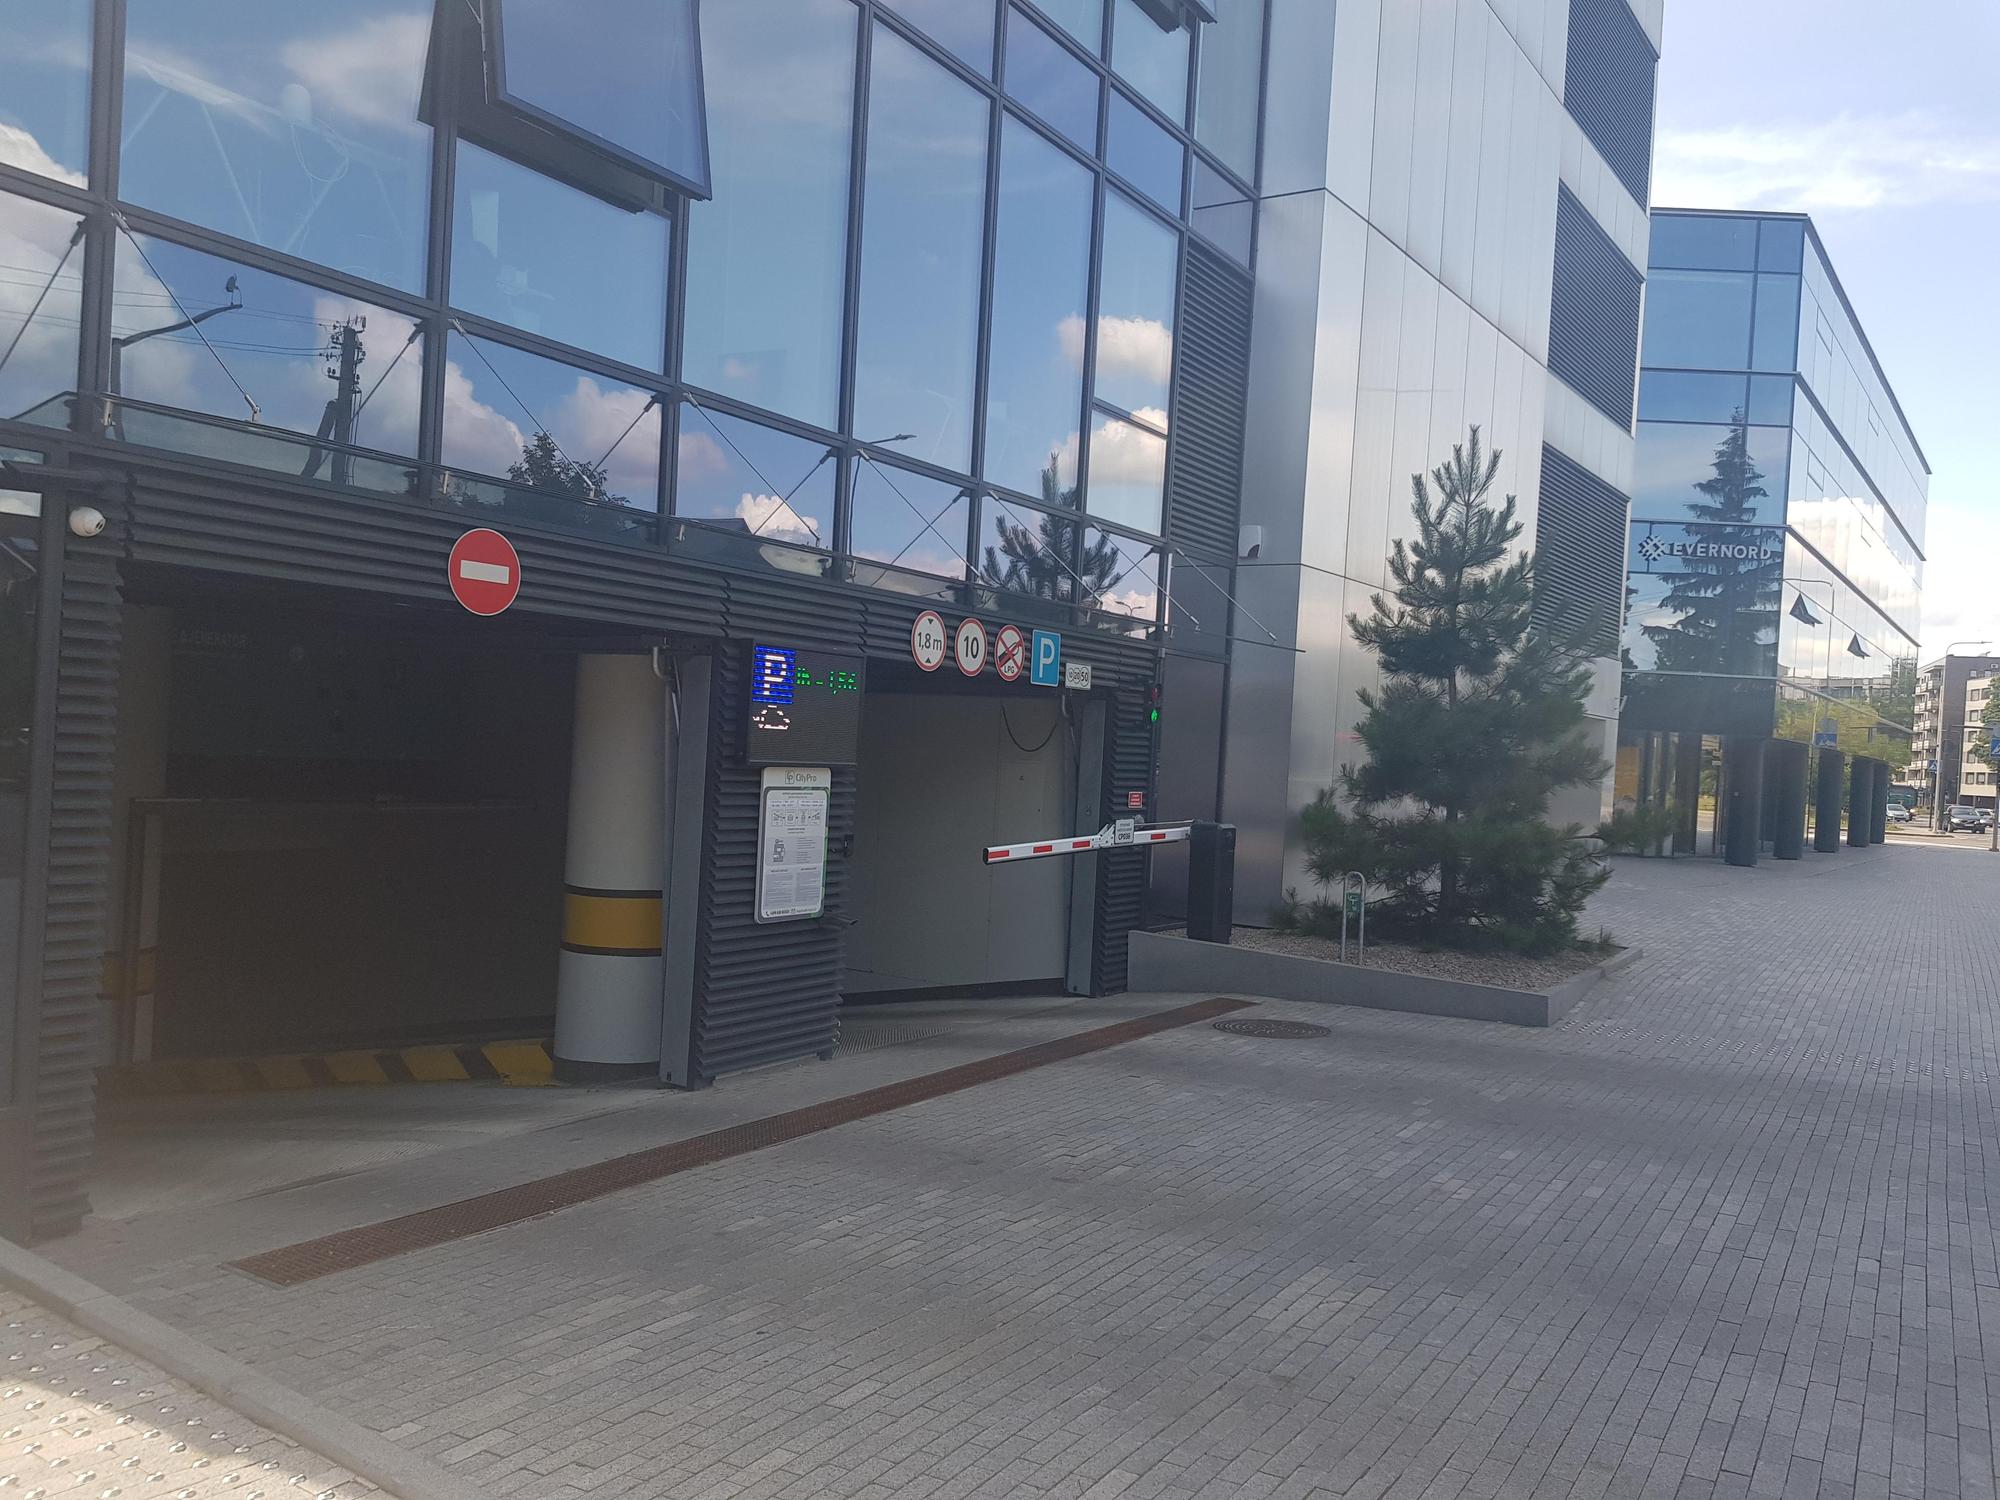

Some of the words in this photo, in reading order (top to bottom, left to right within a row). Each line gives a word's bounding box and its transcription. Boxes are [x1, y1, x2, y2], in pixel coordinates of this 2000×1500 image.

[1673, 543, 1771, 560] EVERNORD
[917, 632, 931, 650] 1,8
[963, 635, 979, 659] 10
[1038, 637, 1055, 679] P
[763, 654, 787, 696] P
[1003, 665, 1015, 674] LPG
[1081, 671, 1089, 682] 50
